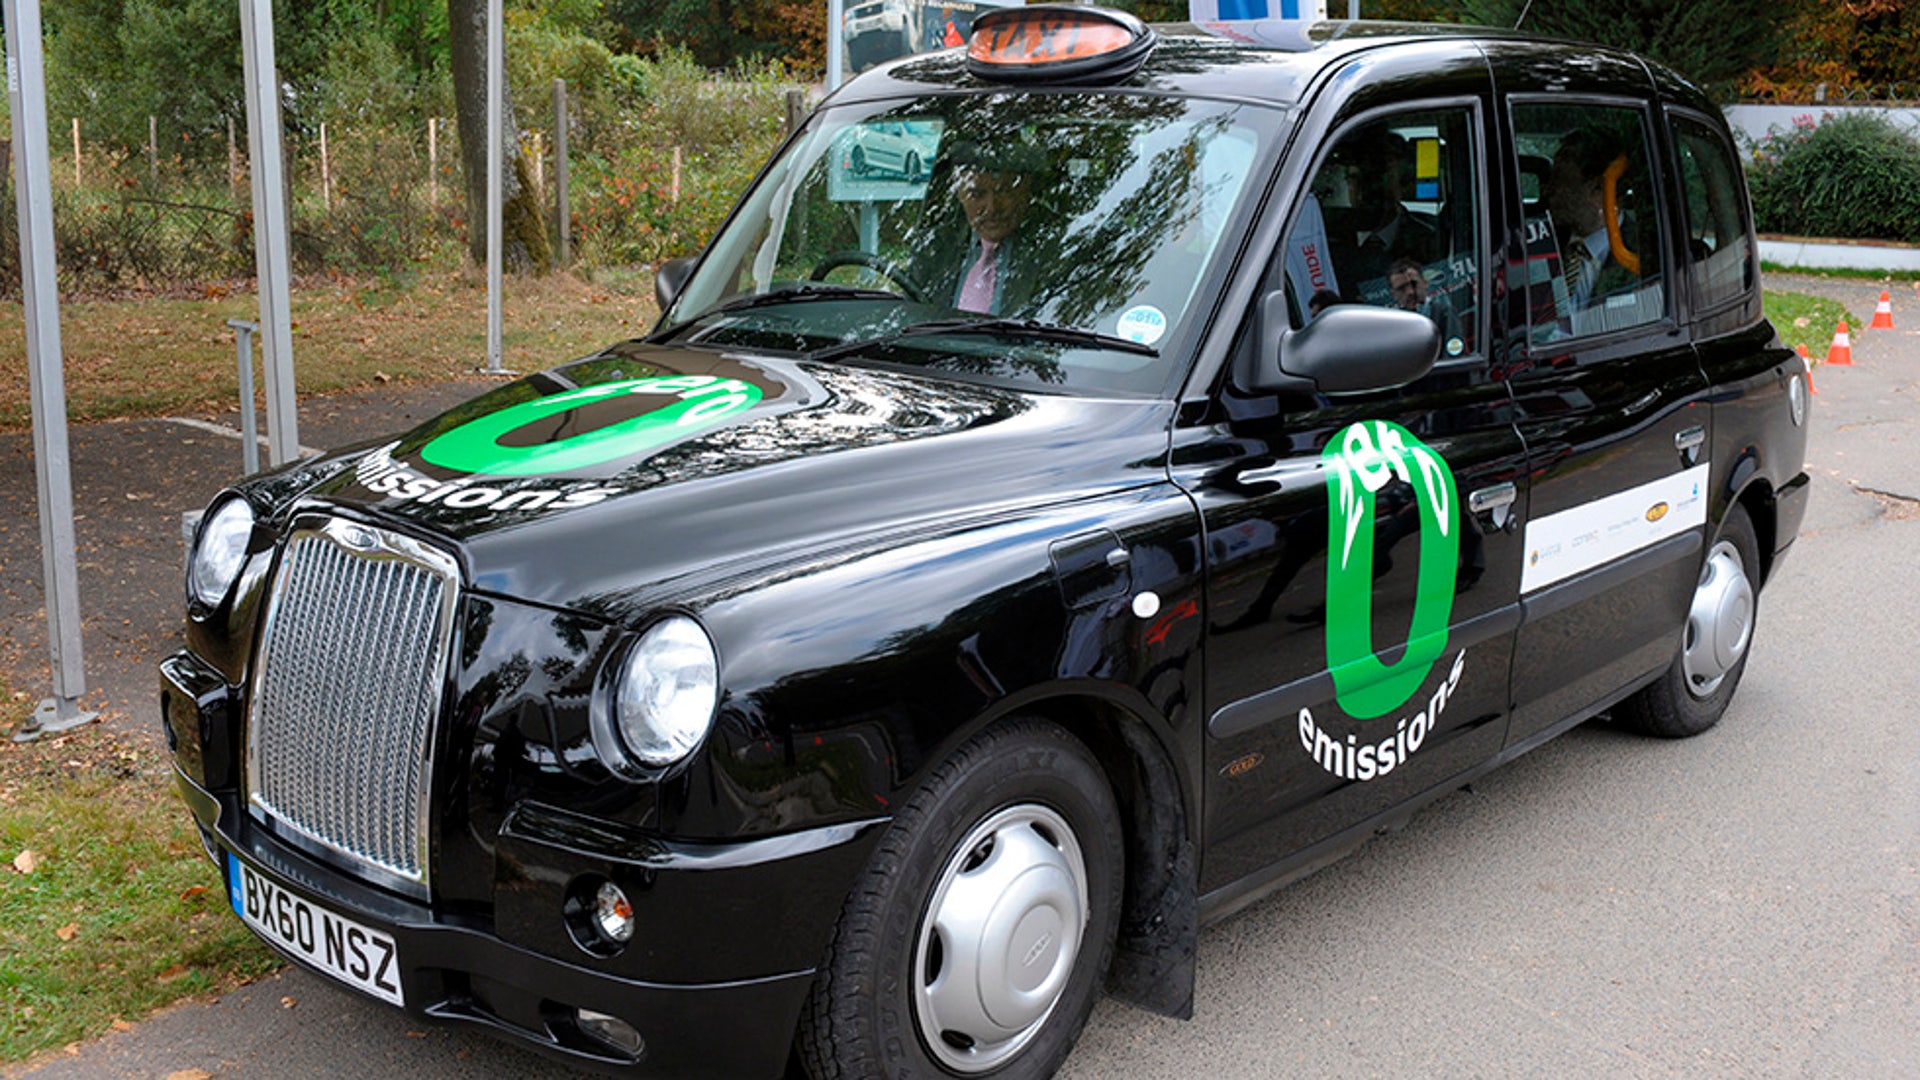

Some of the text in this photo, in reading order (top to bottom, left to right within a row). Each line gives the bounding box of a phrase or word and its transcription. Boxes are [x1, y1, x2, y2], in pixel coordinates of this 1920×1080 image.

[989, 22, 1081, 58] TAXI
[1298, 648, 1467, 781] emissions
[245, 868, 397, 995] BX60 NSZ
